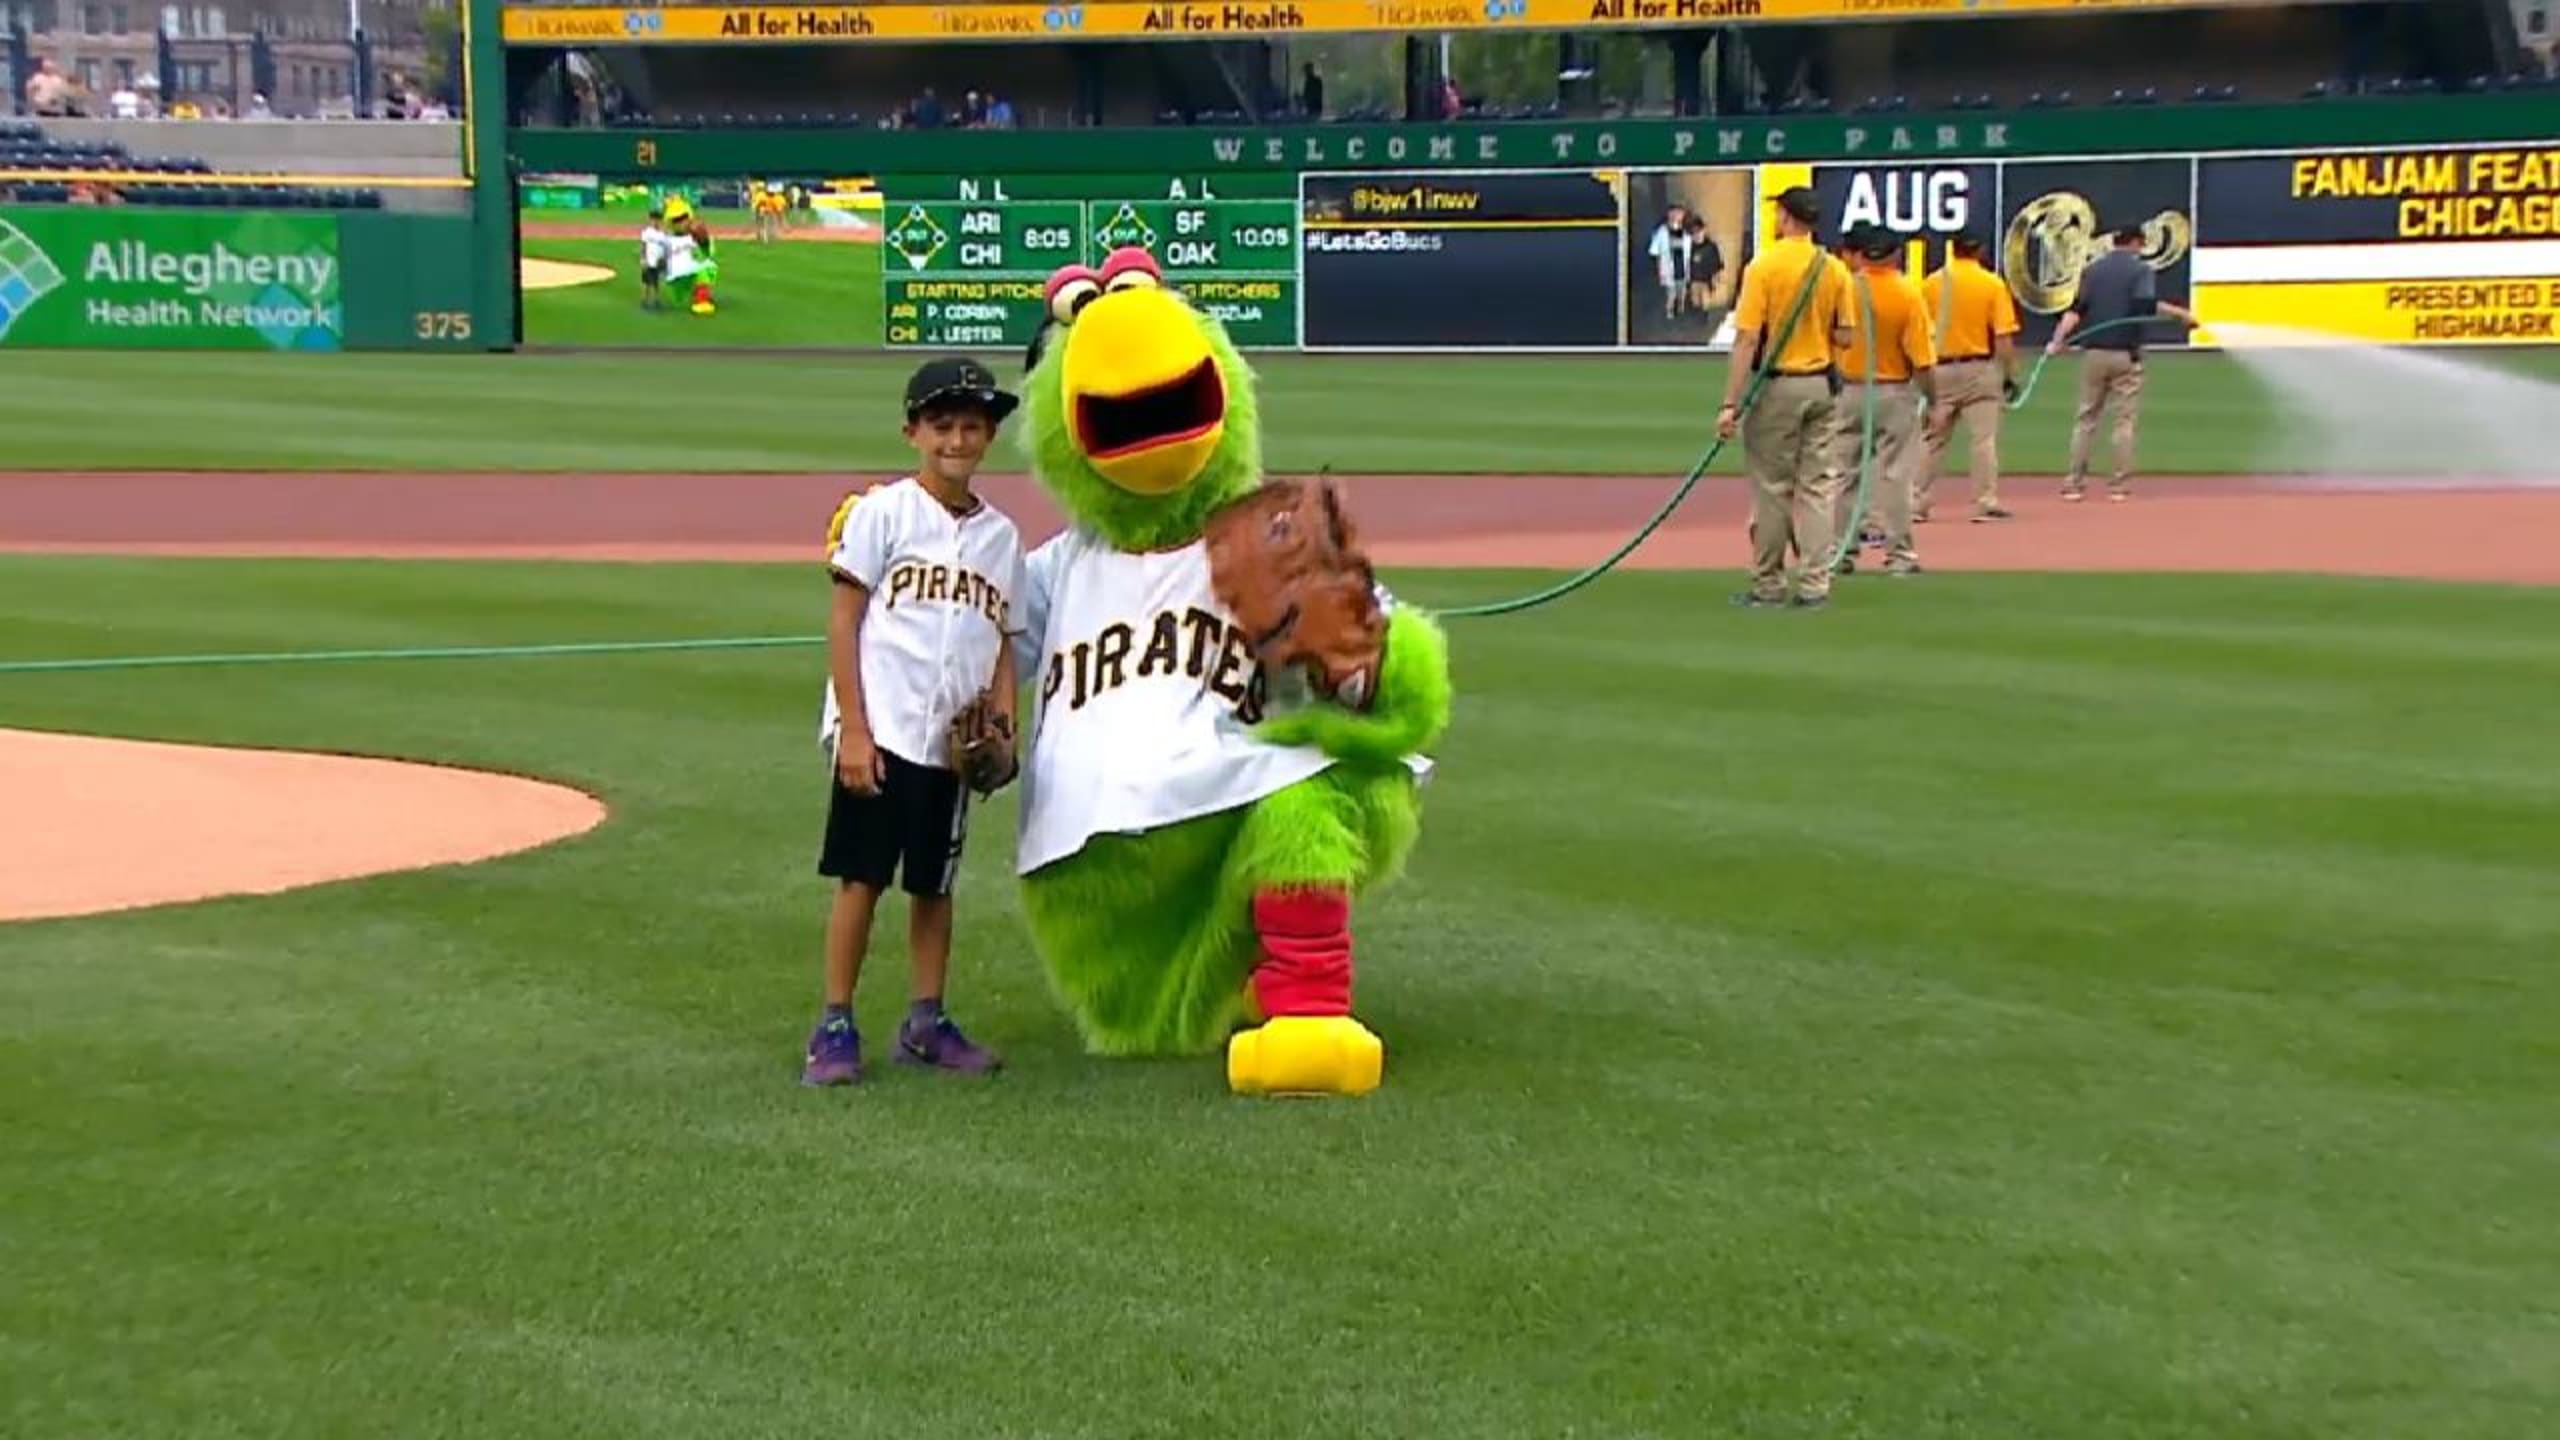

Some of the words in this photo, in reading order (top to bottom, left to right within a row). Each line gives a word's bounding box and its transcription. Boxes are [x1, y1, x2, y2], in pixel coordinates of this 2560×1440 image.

[1143, 6, 1173, 31] All
[1181, 6, 1215, 30] for
[1222, 3, 1304, 29] Health
[1591, 0, 1625, 18] All
[1633, 0, 1667, 17] for
[1675, 0, 1761, 17] Health
[721, 13, 750, 36] All
[757, 13, 790, 35] for
[797, 11, 874, 35] Health
[637, 139, 656, 166] 21
[1213, 136, 1498, 162] WELCOME
[1551, 133, 1616, 159] TO
[1674, 130, 1786, 155] PNC
[1844, 124, 2009, 151] PARK
[2292, 155, 2458, 197] FANJAM
[2468, 151, 2560, 193] FEAT
[1841, 170, 1968, 233] AUG
[960, 211, 1001, 234] ARI
[1175, 210, 1205, 234] SF
[1024, 228, 1071, 249] 8:05
[960, 243, 1001, 266] CHI
[1167, 242, 1217, 265] OAK
[84, 240, 338, 294] Allegheny
[906, 283, 986, 299] STARTING
[991, 283, 1046, 299] PITCHE
[2386, 284, 2538, 309] PRESENTED
[86, 298, 191, 327] Health
[201, 299, 333, 328] Network
[414, 312, 472, 340] 375
[2415, 314, 2553, 339] HIGHMARK
